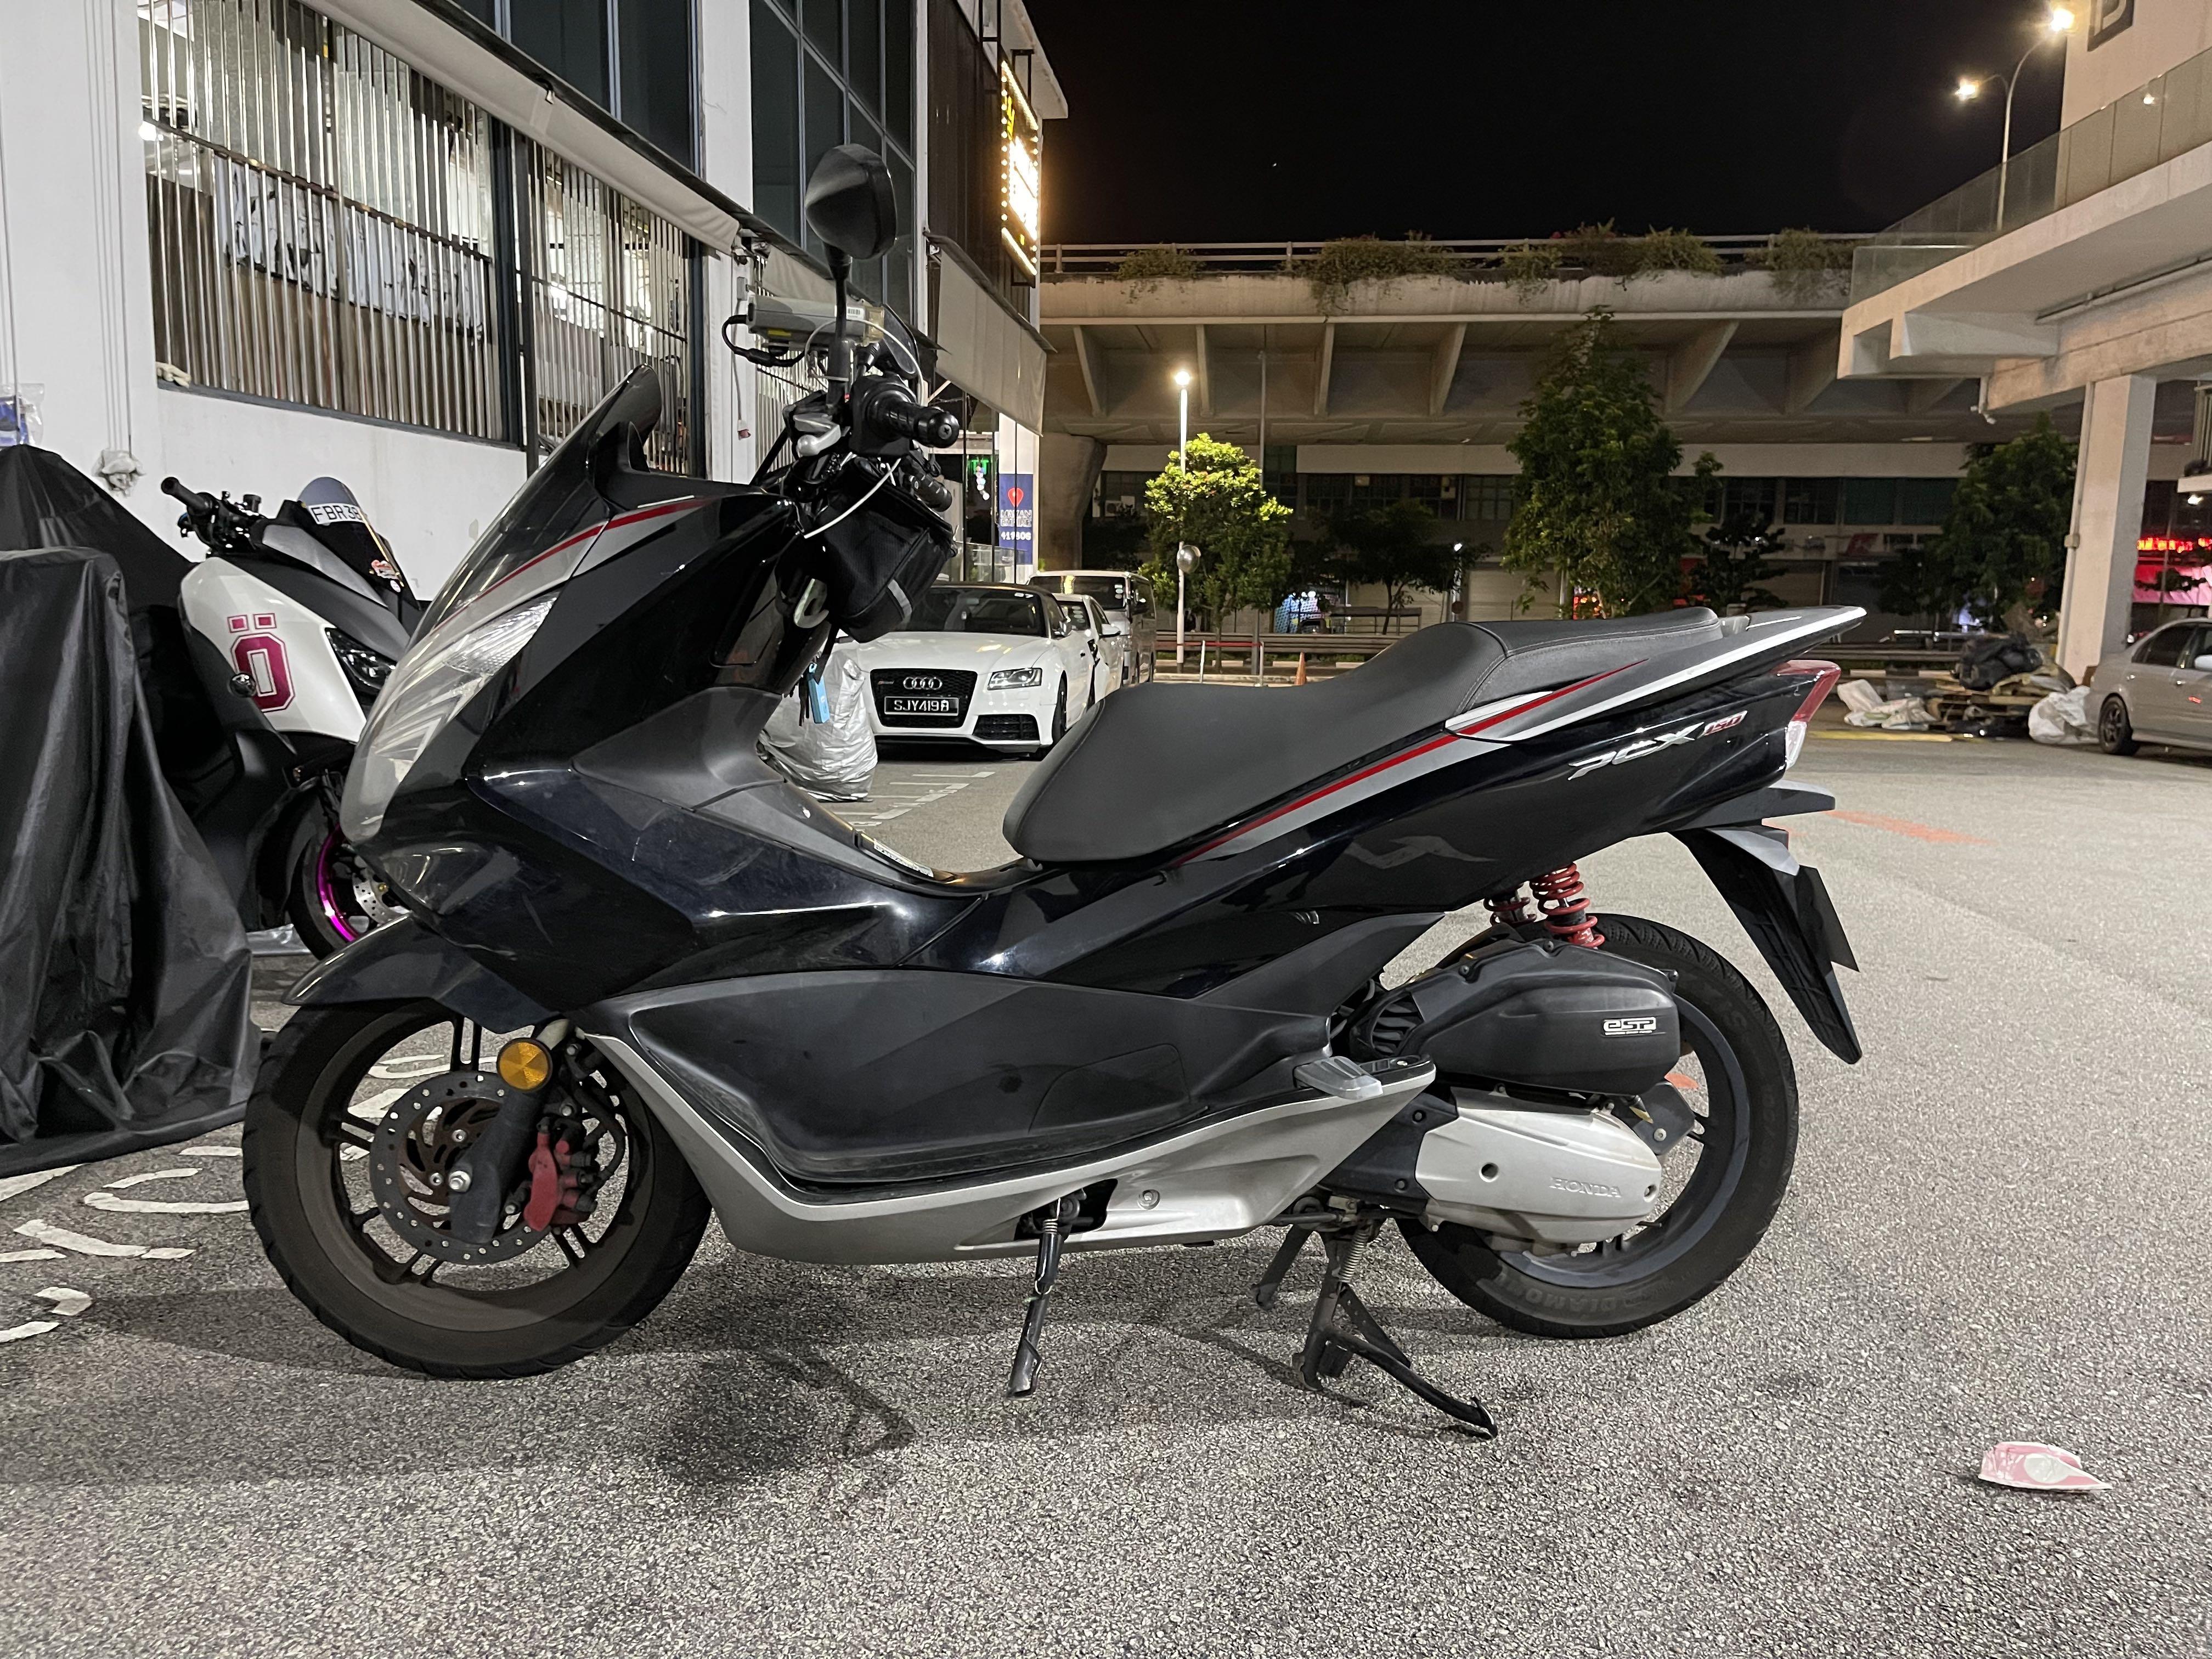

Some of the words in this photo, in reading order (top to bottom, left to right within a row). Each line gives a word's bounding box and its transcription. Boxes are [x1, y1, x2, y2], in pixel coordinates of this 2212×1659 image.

[1567, 721, 1705, 780] PCX
[1703, 712, 1746, 735] 150
[1549, 1176, 1622, 1198] HONDA
